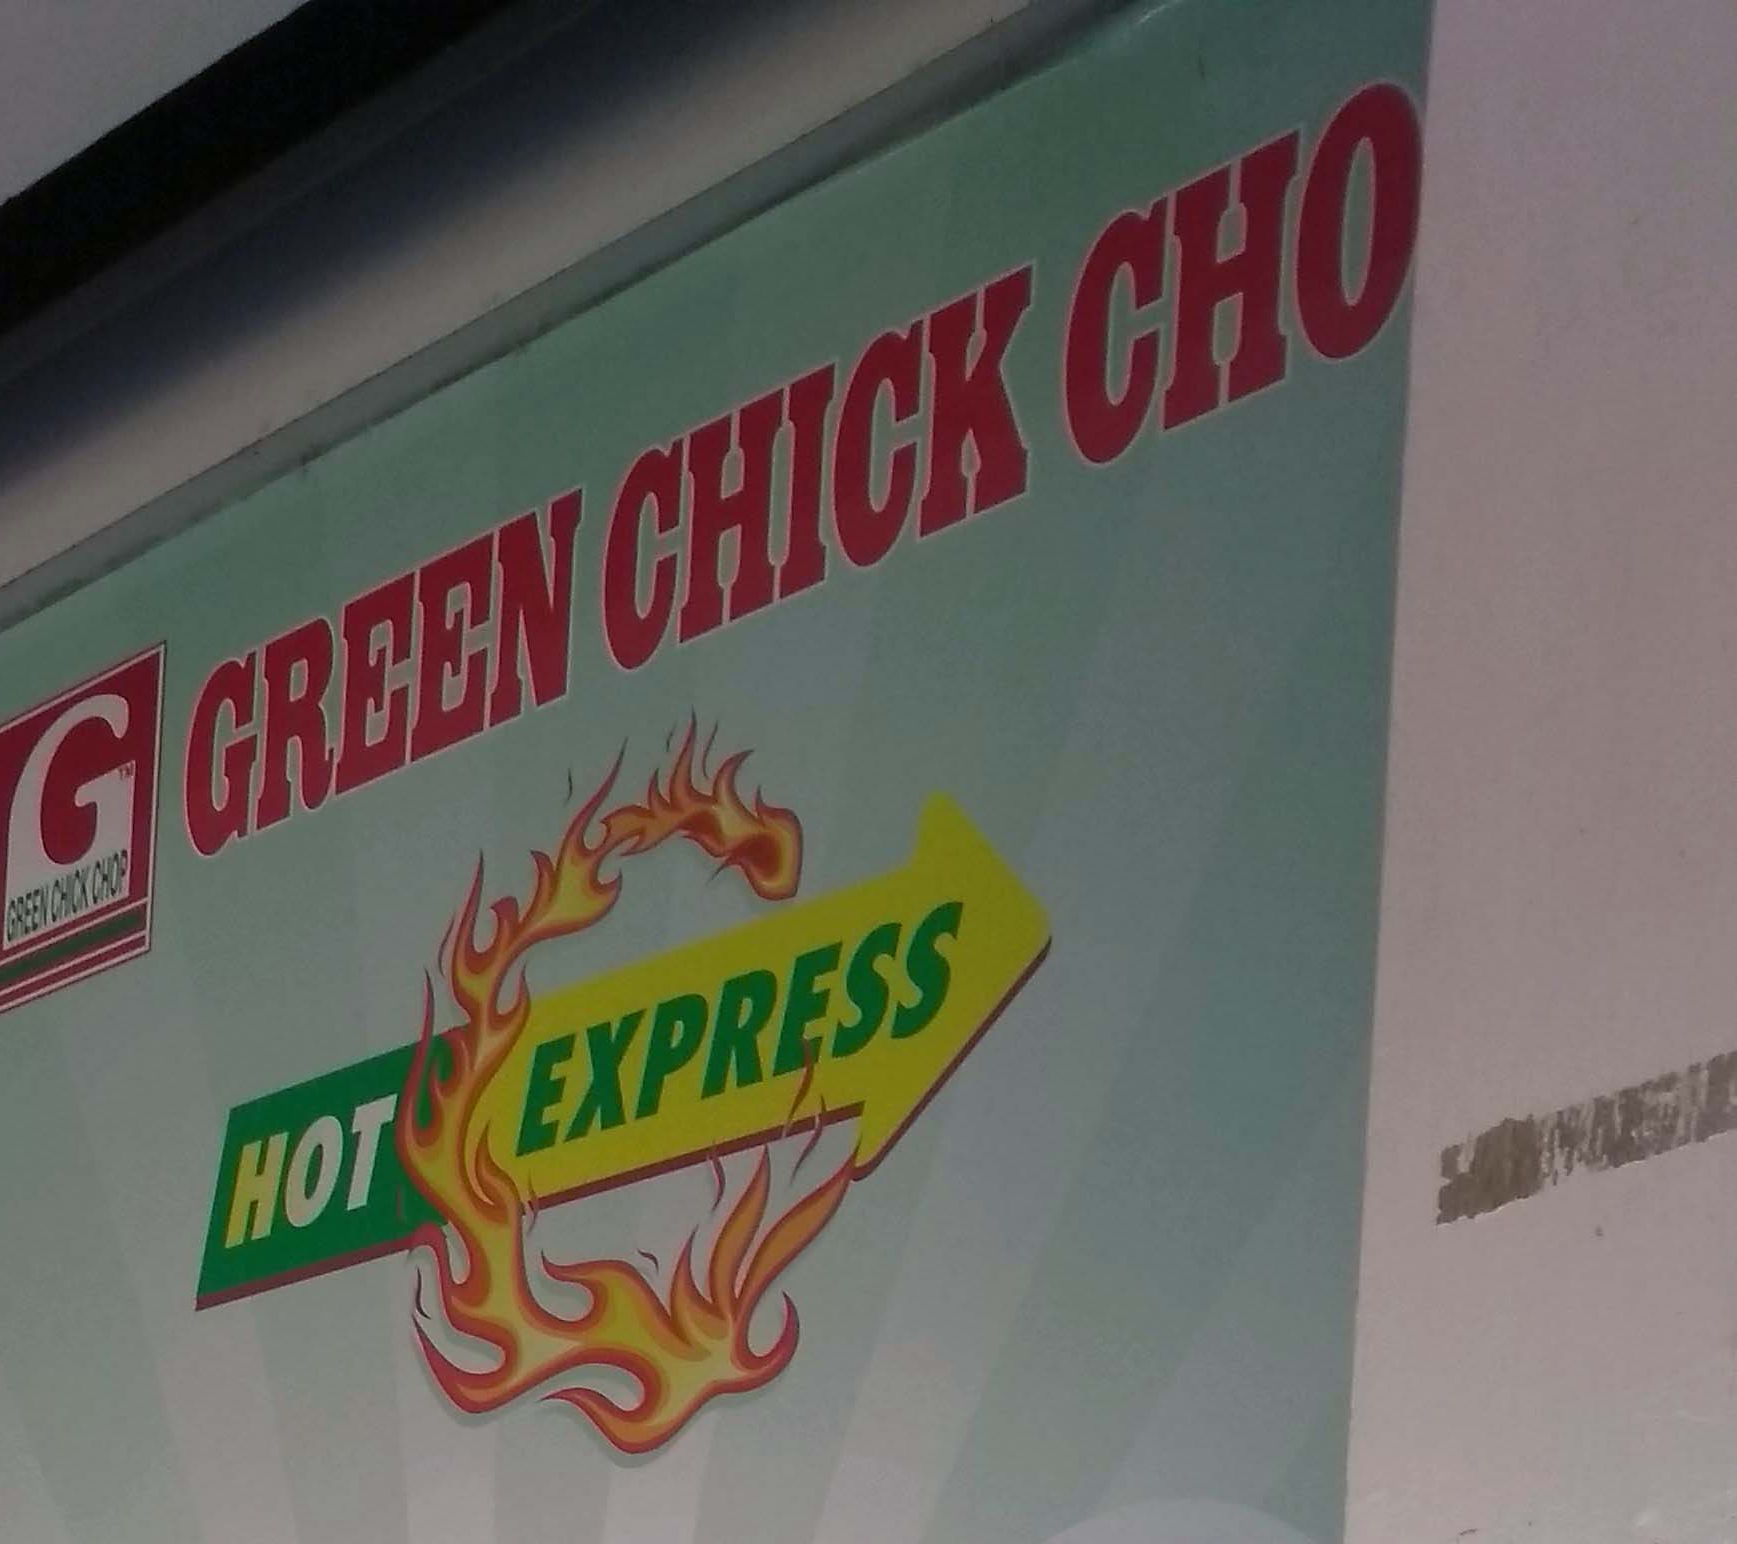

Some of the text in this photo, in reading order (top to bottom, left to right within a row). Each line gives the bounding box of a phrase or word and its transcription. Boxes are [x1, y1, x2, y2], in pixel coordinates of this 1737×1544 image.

[182, 81, 1425, 859] GREEN CHICK CHO
[7, 849, 128, 942] GREEN CHICK CHOP
[223, 901, 965, 1250] HOT EXPRESS
